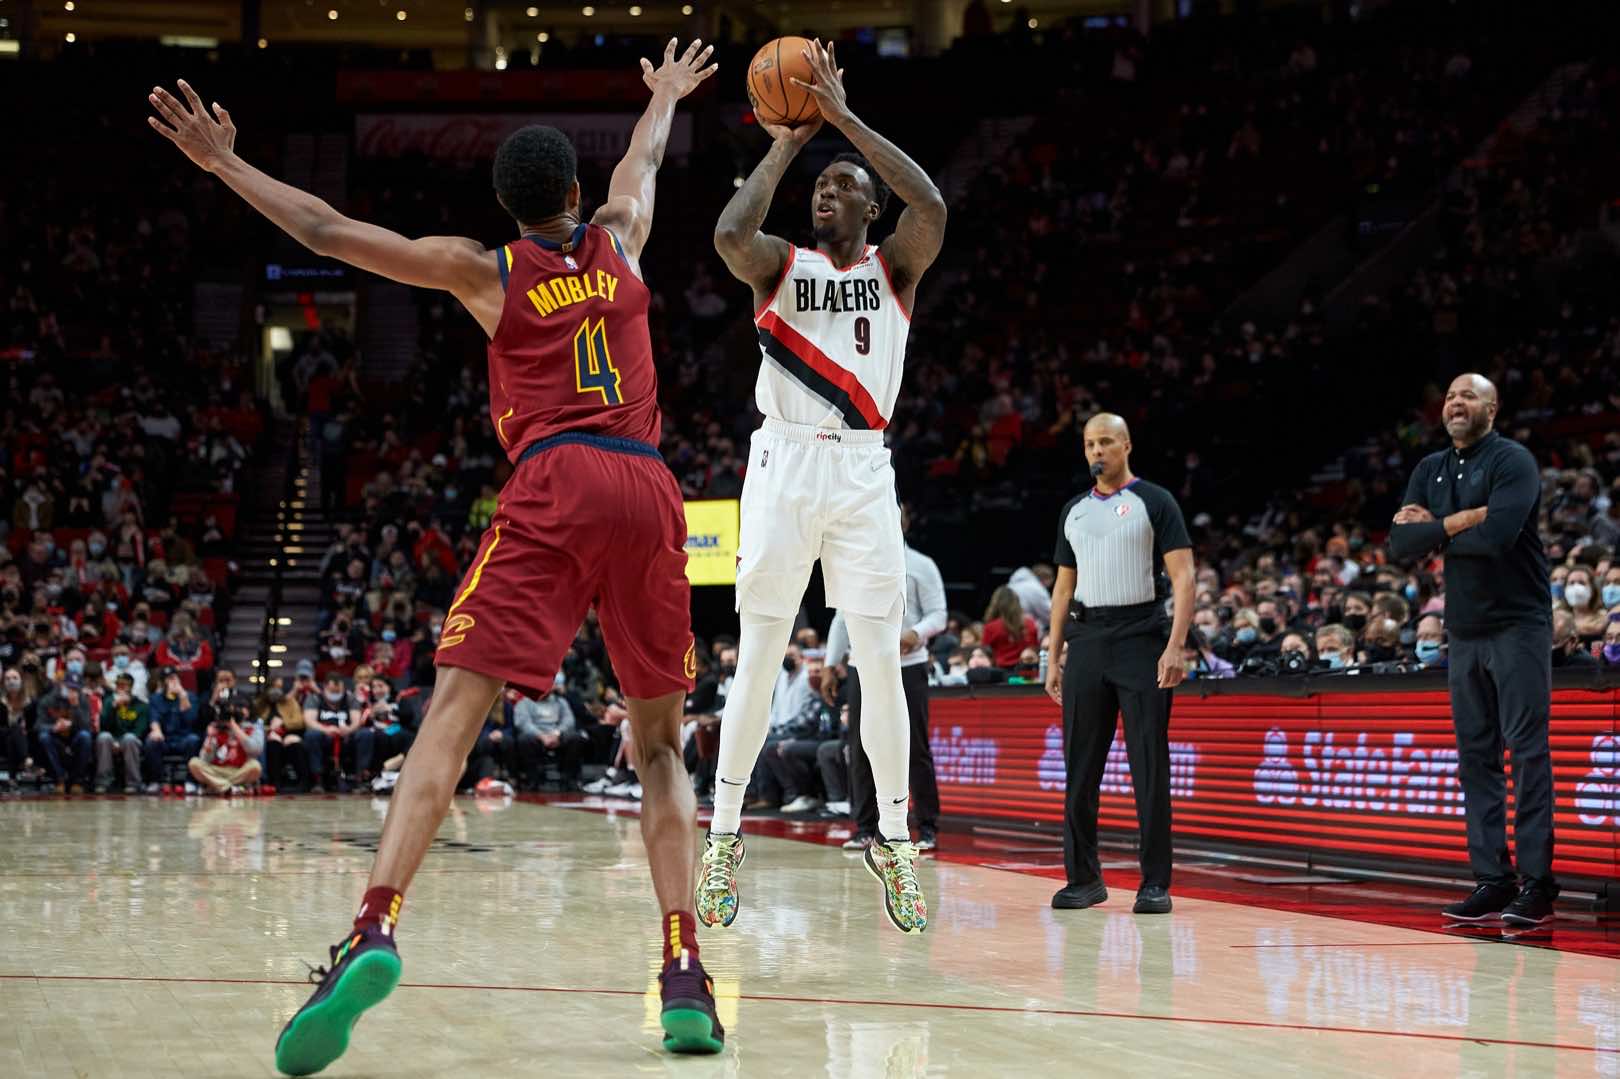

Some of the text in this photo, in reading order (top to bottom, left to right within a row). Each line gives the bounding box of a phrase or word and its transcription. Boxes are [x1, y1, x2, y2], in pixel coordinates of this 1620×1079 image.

[526, 269, 619, 318] MOBLEY
[854, 316, 871, 356] 9
[574, 316, 625, 406] 4
